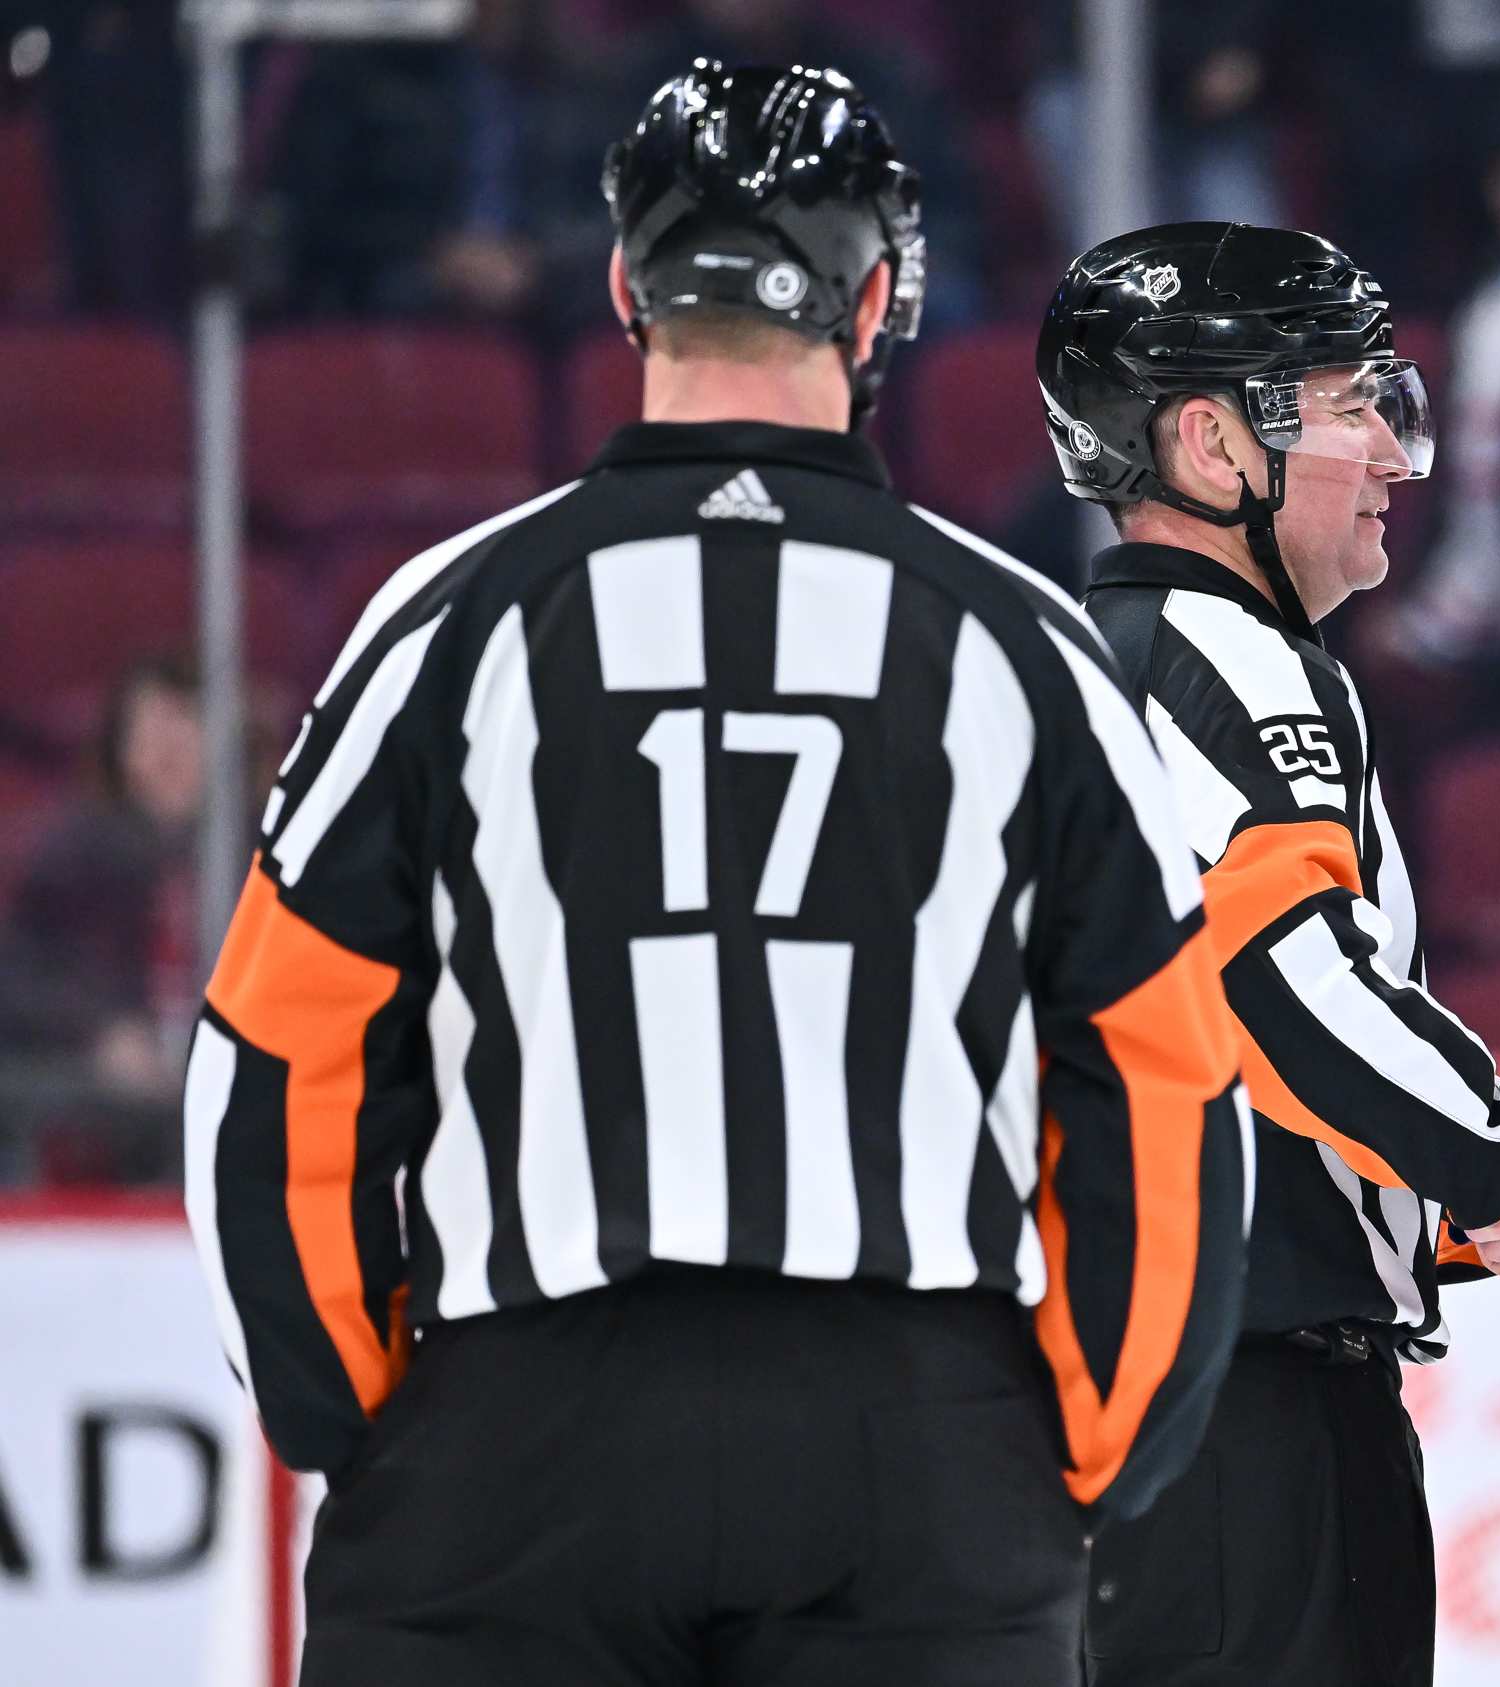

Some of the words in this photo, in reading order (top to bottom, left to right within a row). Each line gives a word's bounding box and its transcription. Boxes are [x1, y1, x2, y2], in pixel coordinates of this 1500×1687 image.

[1262, 418, 1300, 430] BAUER
[1259, 724, 1341, 775] 25
[637, 707, 843, 918] 17
